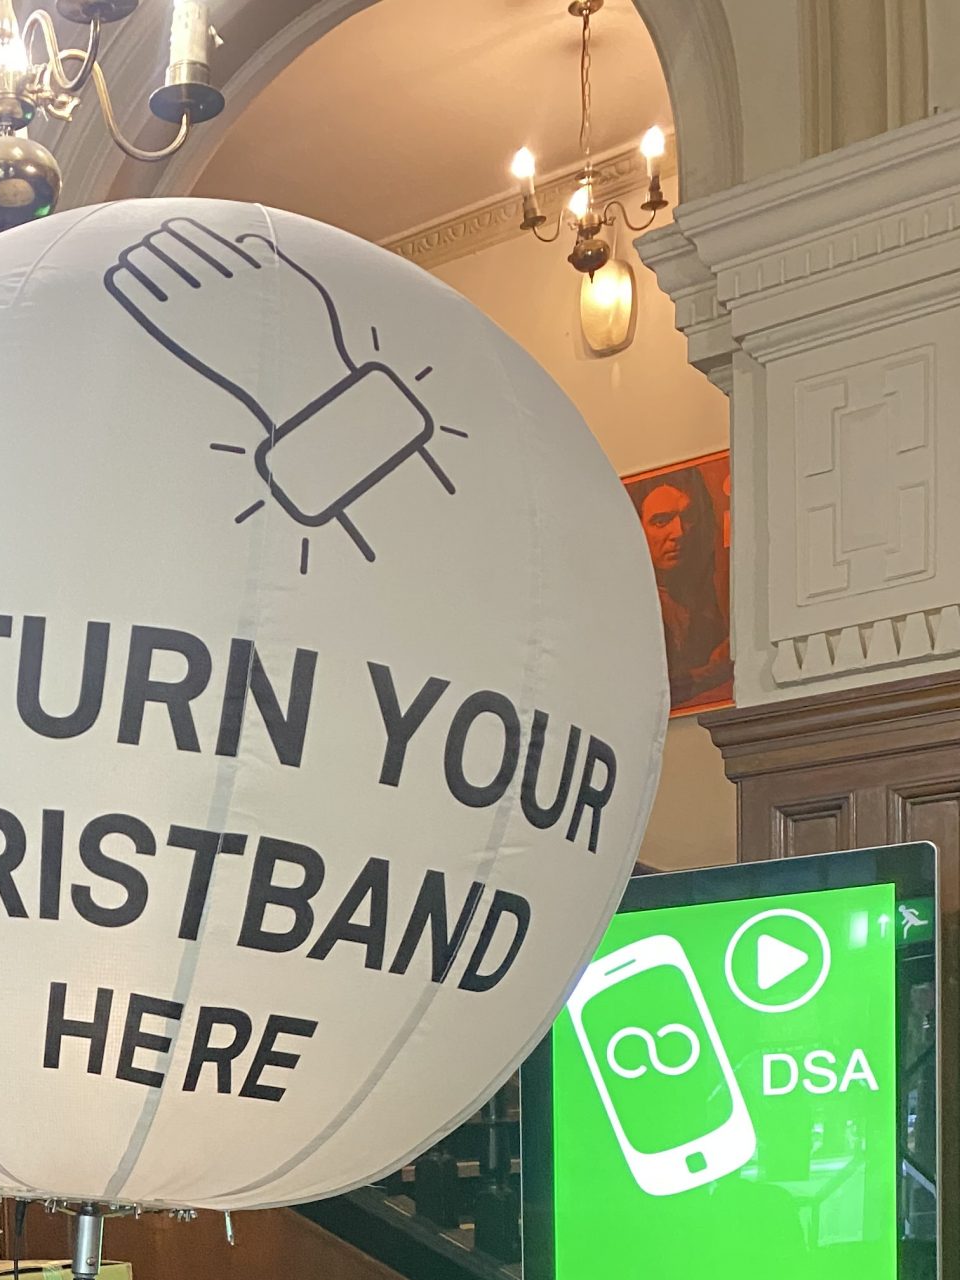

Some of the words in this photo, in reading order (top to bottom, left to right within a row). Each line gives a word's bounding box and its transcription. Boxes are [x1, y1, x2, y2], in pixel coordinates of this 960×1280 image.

[366, 661, 617, 855] YOUR
[43, 982, 319, 1102] HERE
[762, 1048, 880, 1096] DSA
